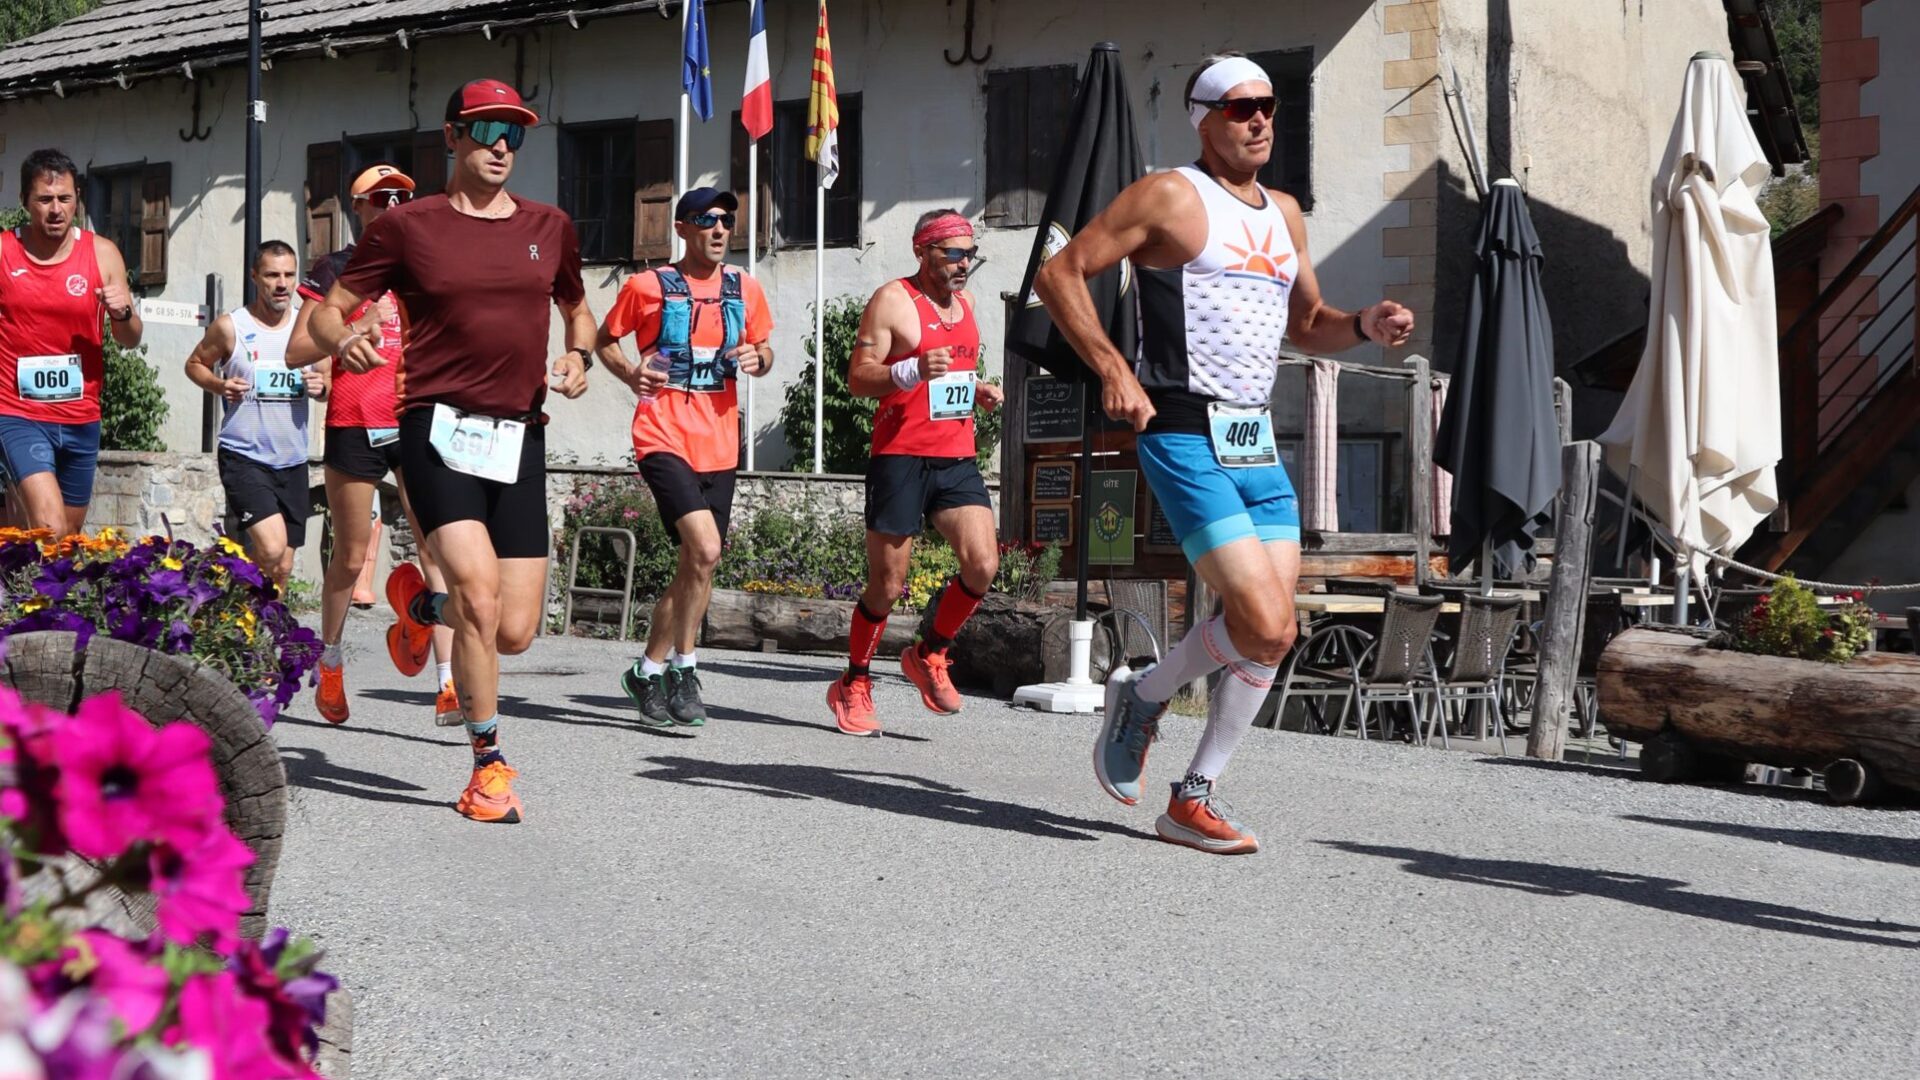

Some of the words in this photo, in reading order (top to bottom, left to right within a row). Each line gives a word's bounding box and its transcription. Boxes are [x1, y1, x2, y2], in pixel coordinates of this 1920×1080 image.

[34, 369, 69, 389] 060
[269, 372, 296, 389] 276
[945, 385, 970, 405] 272
[1225, 420, 1260, 447] 409
